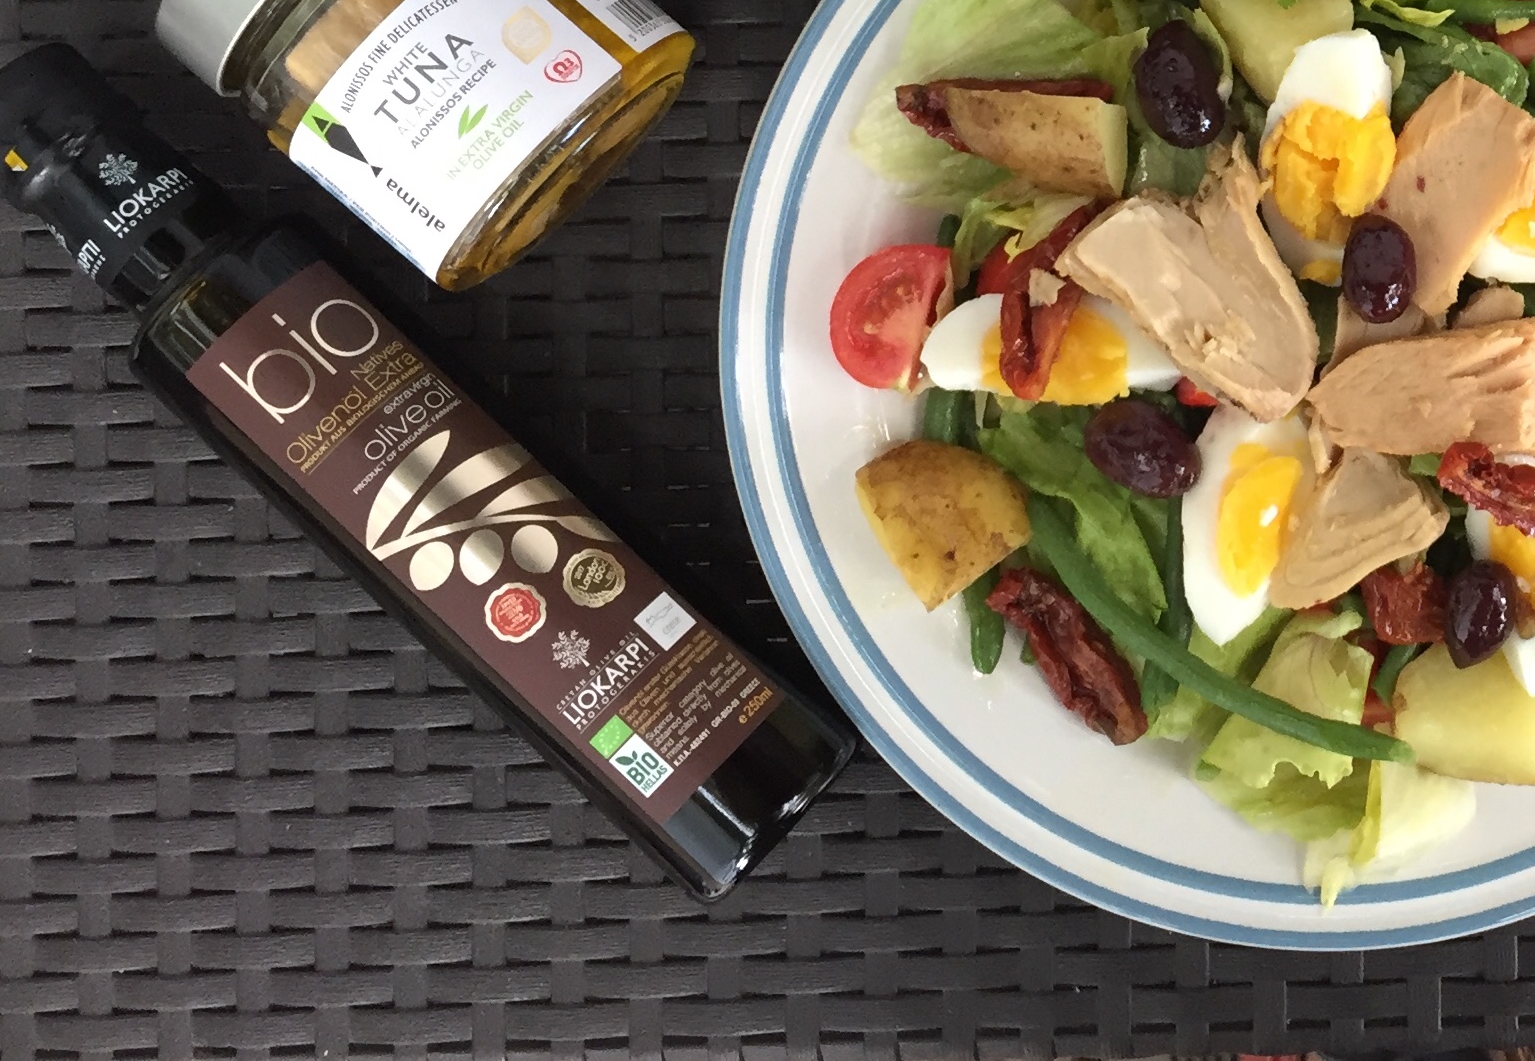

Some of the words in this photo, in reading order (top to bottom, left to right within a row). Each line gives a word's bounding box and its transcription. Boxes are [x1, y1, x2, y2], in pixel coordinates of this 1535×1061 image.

[340, 62, 374, 114] ALONISSOS
[367, 39, 392, 64] FINE
[373, 33, 475, 124] TUNA
[382, 41, 428, 86] WHITE
[410, 91, 463, 149] ALONISSOS
[459, 58, 497, 96] RECIPE
[446, 165, 461, 180] IN
[458, 129, 496, 168] EXTRA
[491, 89, 534, 129] VIRGIN
[472, 136, 505, 171] OLIVE
[502, 119, 525, 139] OIL
[103, 167, 188, 233] LIOKARPI
[386, 178, 446, 232] alelma
[219, 298, 380, 425] bio
[350, 340, 404, 381] Natives
[286, 385, 368, 464] Olivenöl
[364, 352, 417, 391] Extra
[300, 441, 332, 474] PRODUKT
[331, 426, 347, 443] AUS
[353, 460, 388, 495] PRODUCT
[386, 448, 398, 462] OF
[397, 420, 432, 452] ORGANIC
[431, 398, 463, 424] FARMING
[562, 637, 650, 725] LIOKARPI
[575, 650, 656, 730] PROTOGERAKIS
[743, 686, 774, 717] 250ml
[660, 737, 675, 754] and
[700, 699, 713, 712] by
[626, 752, 660, 786] BIO
[641, 765, 668, 793] HELLAS
